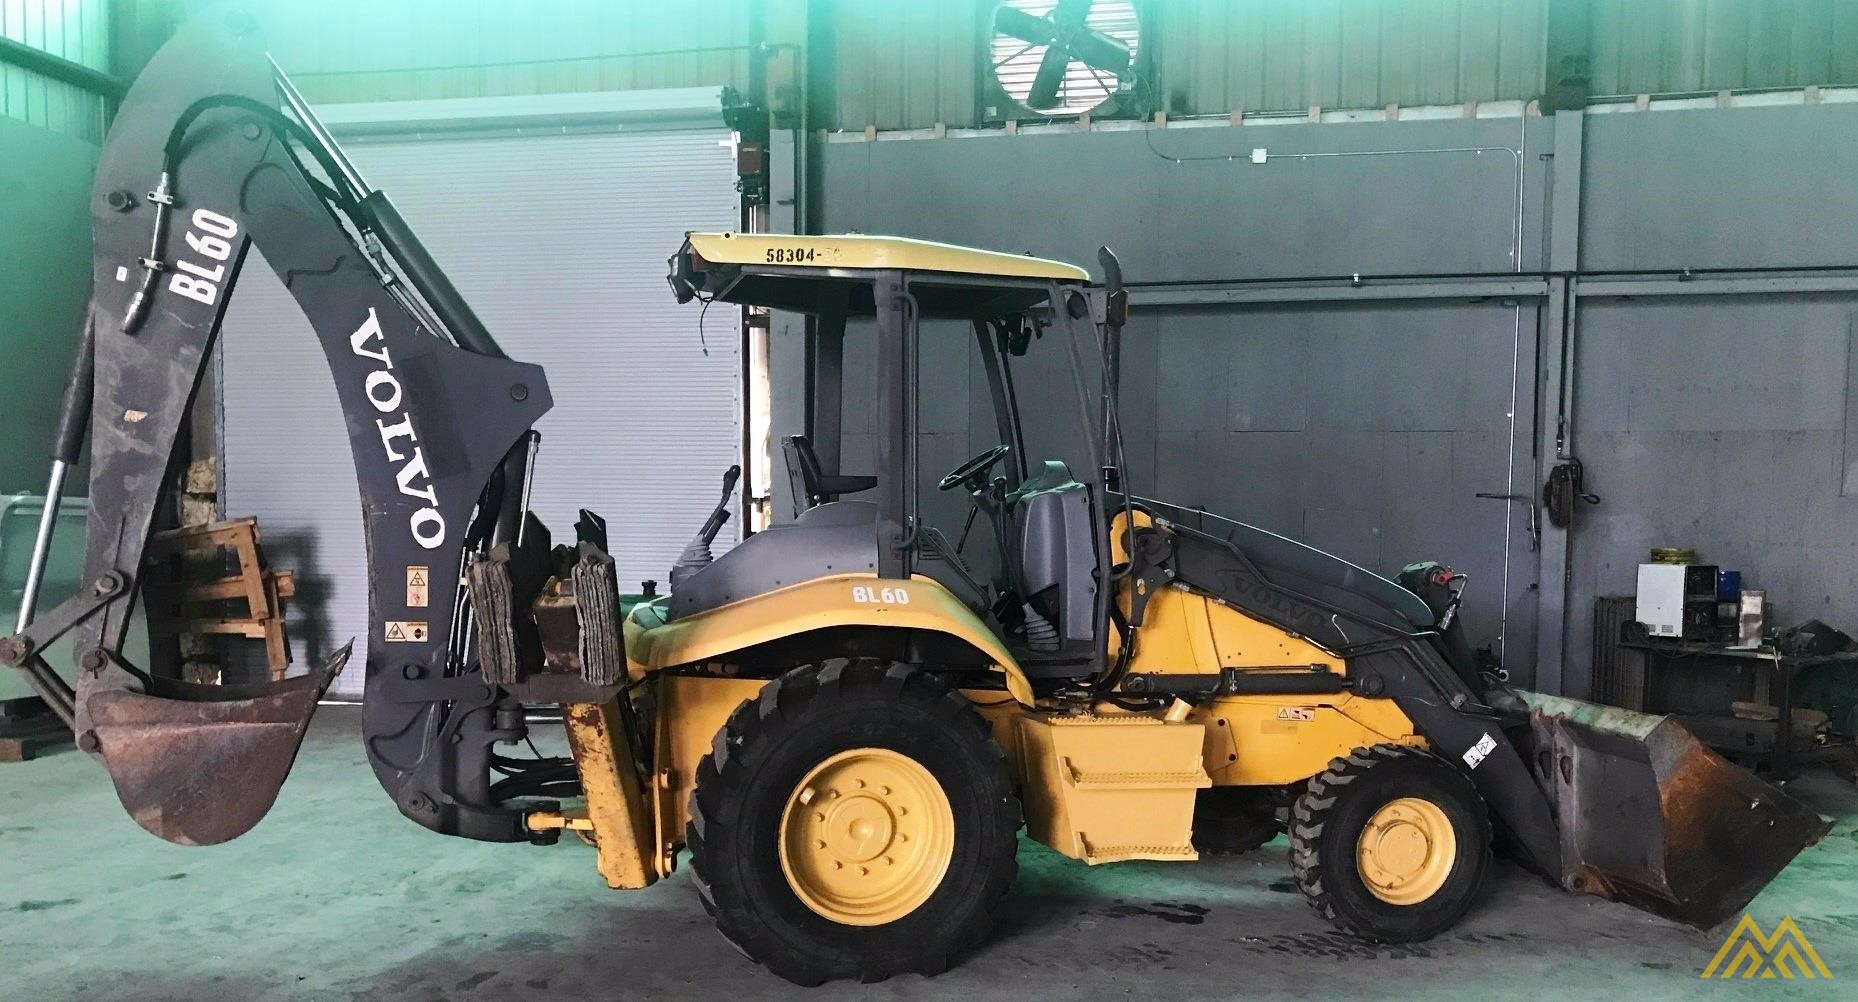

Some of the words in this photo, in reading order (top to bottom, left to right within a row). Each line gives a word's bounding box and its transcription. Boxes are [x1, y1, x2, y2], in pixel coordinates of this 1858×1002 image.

[168, 208, 238, 306] BL60
[350, 307, 446, 549] VOLVO
[852, 586, 910, 605] BL60
[1232, 573, 1327, 631] VOLVO
